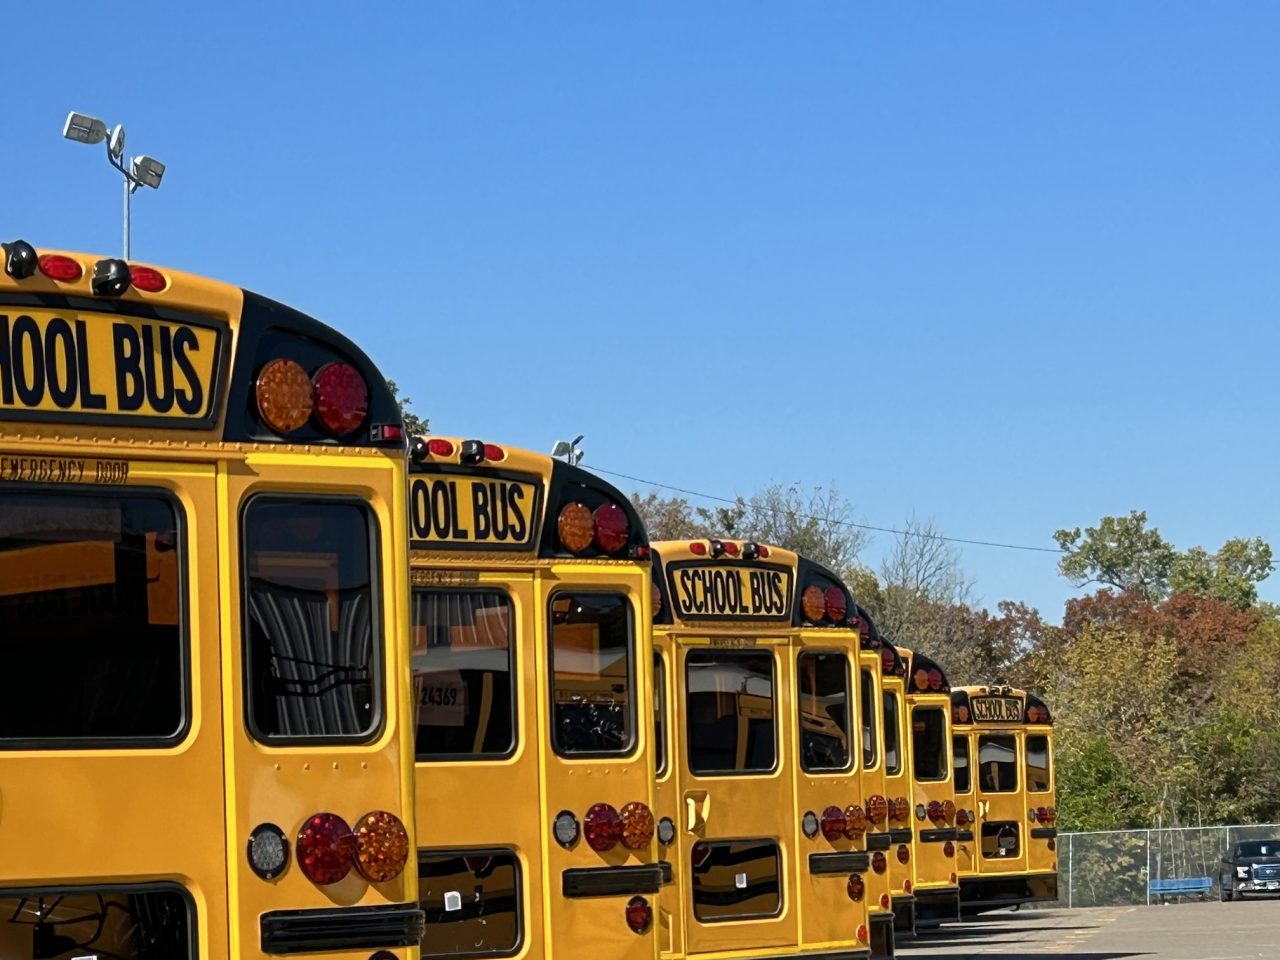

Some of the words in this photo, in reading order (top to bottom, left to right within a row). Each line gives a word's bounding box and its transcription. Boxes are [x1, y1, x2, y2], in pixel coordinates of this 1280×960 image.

[112, 322, 203, 415] BUS
[0, 457, 85, 482] EMERGENCY
[96, 460, 129, 484] DOOR
[409, 479, 468, 539] OOL
[471, 482, 527, 541] BUS
[680, 569, 749, 614] SCHOOL
[749, 571, 785, 615] BUS
[975, 699, 1005, 720] SCHOOL
